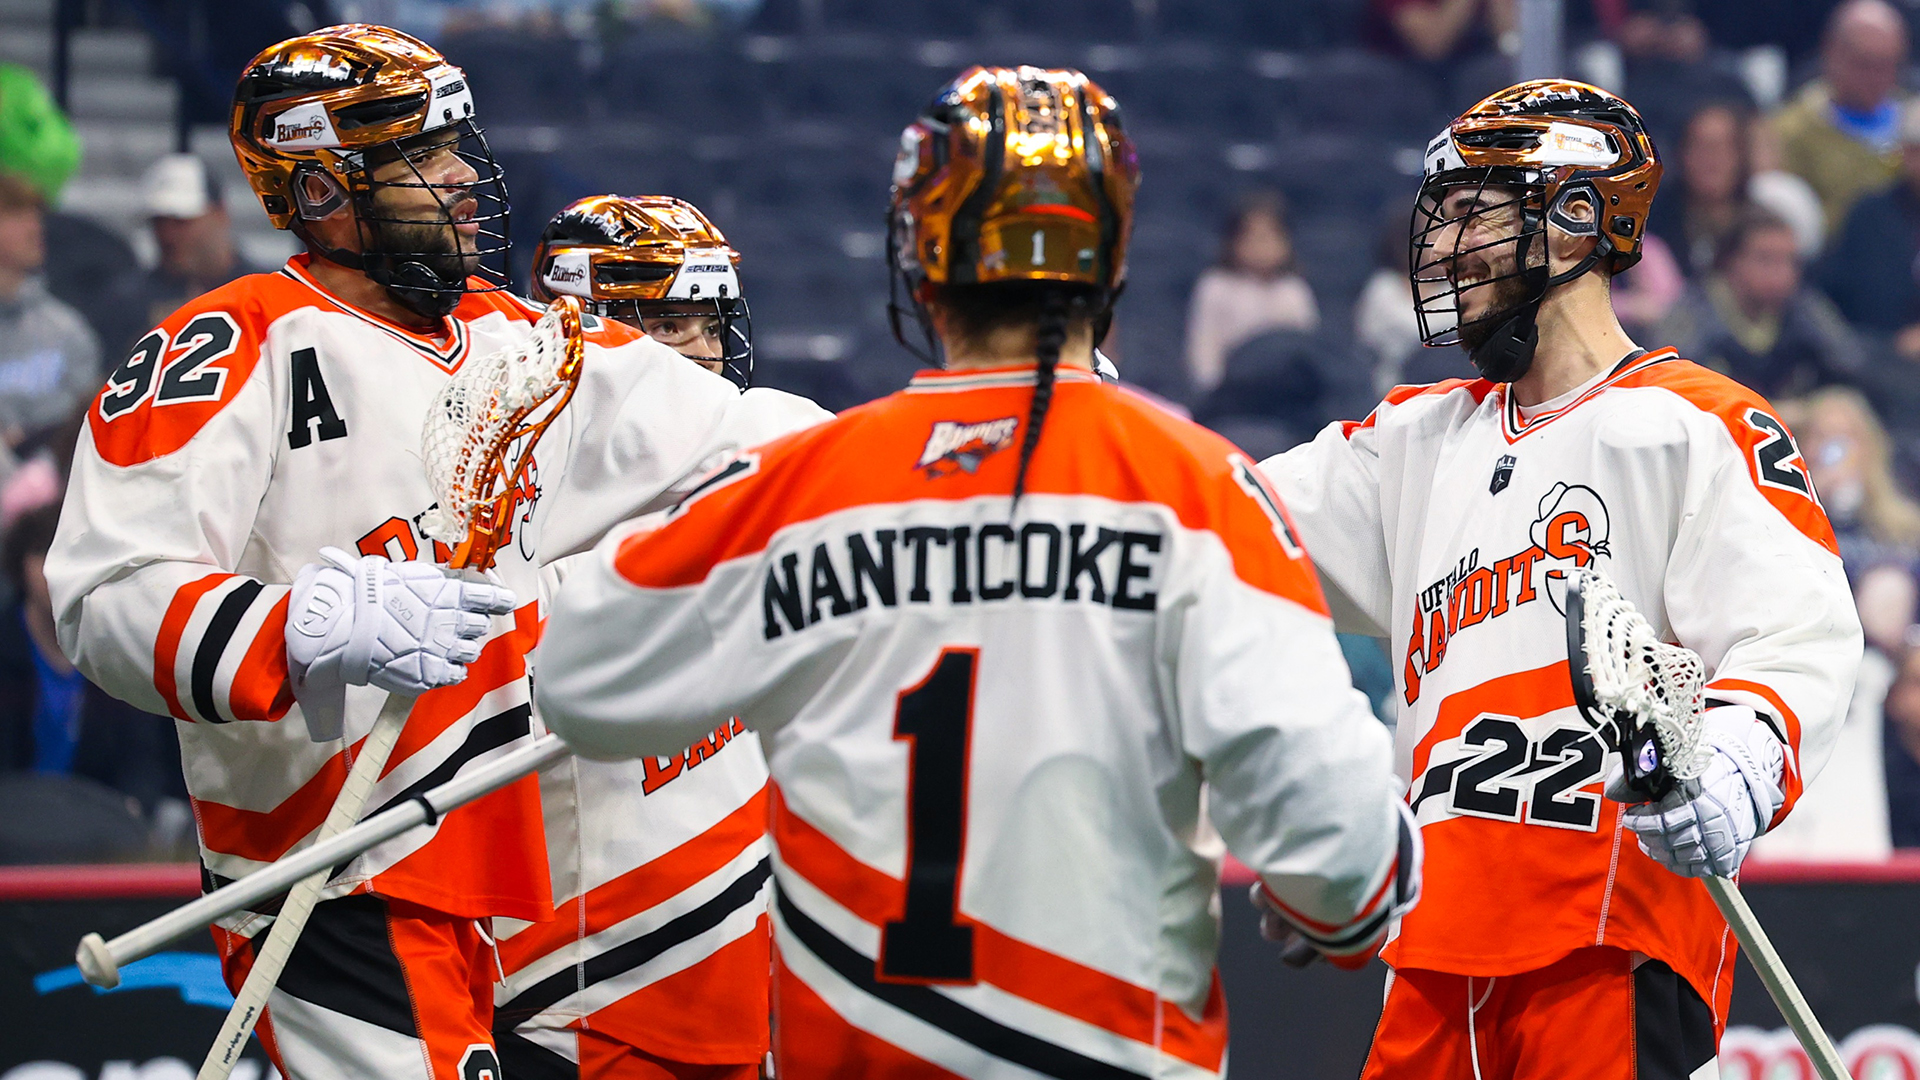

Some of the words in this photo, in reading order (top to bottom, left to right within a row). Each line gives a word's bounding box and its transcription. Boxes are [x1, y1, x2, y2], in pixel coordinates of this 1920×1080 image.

[1032, 230, 1046, 265] 1
[99, 311, 242, 423] 92
[287, 346, 348, 450] A
[1743, 408, 1827, 516] 2
[763, 522, 1162, 640] NANTICOKE
[875, 646, 981, 986] 1
[1447, 712, 1610, 833] 22
